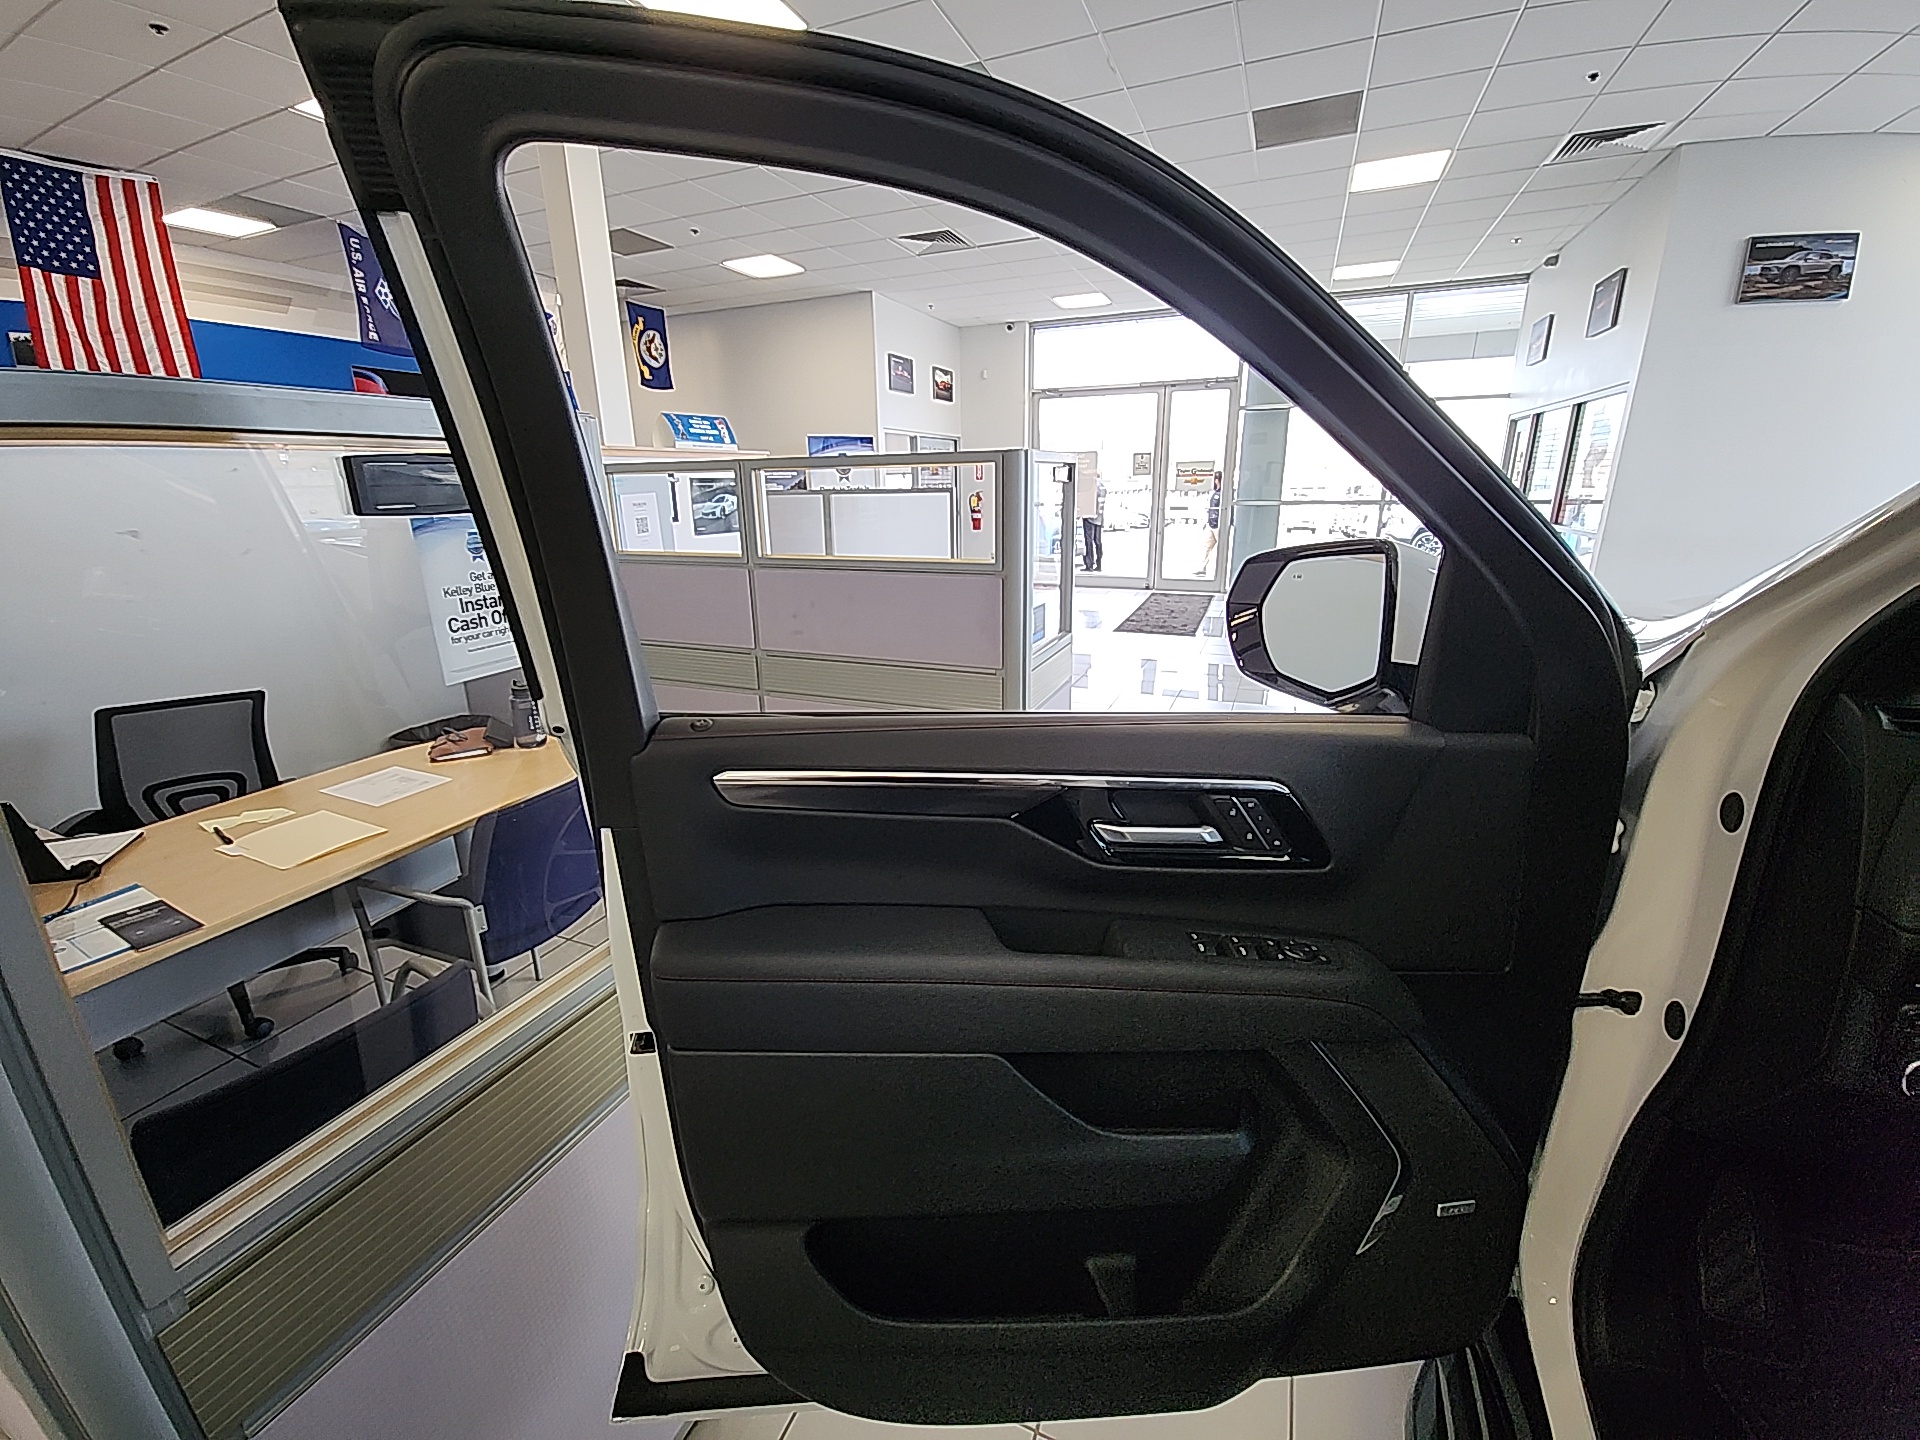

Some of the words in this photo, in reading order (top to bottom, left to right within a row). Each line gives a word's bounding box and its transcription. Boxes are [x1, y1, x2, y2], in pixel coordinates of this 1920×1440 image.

[349, 237, 363, 265] U.S.
[353, 266, 368, 294] AIR
[469, 571, 486, 582] Get
[442, 585, 473, 599] Kelley
[474, 582, 496, 594] Blue
[448, 612, 490, 634] Cash
[450, 636, 462, 645] for
[463, 632, 481, 645] your
[482, 630, 494, 639] car
[494, 625, 509, 637] righ
